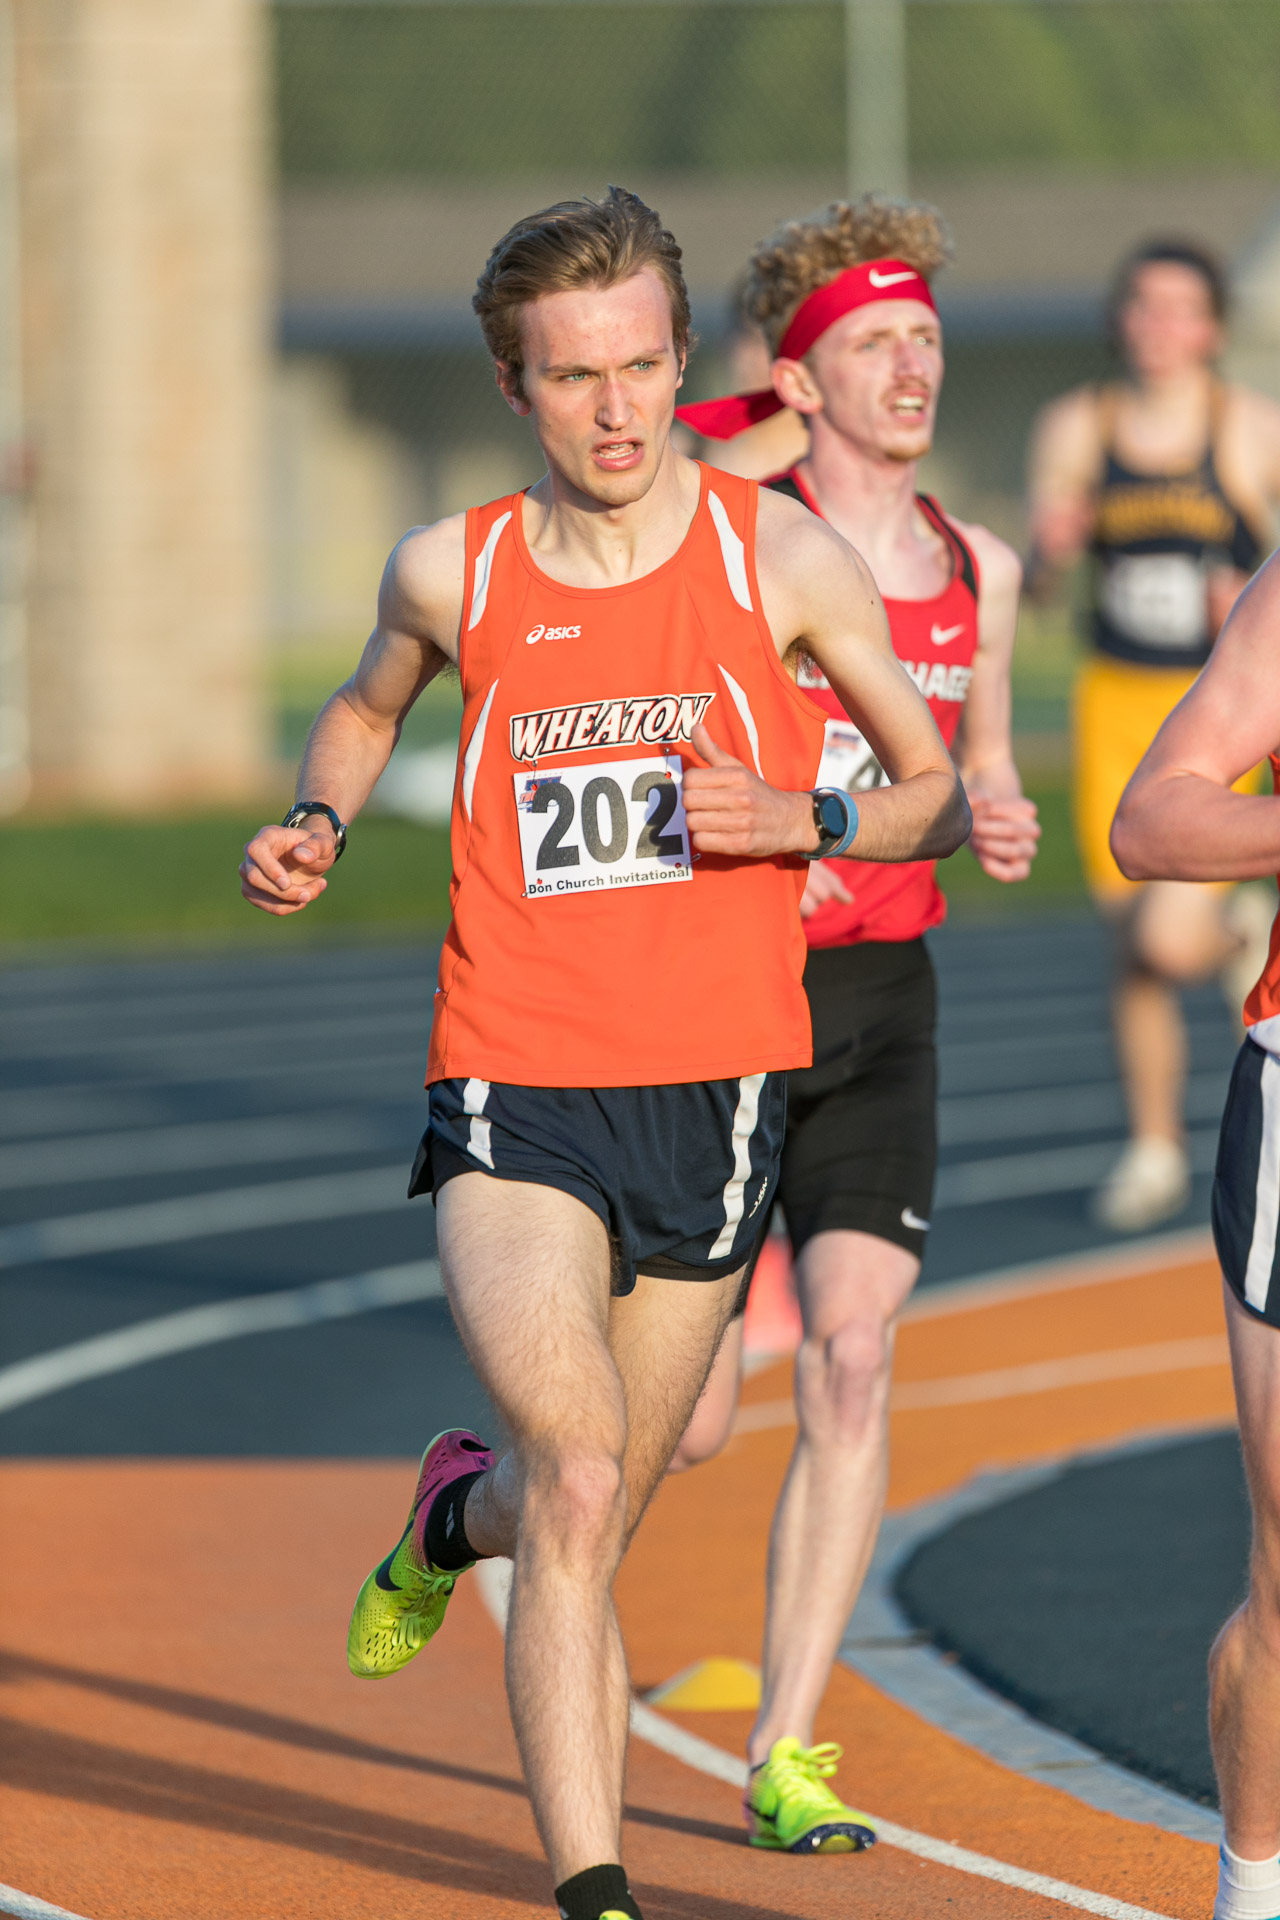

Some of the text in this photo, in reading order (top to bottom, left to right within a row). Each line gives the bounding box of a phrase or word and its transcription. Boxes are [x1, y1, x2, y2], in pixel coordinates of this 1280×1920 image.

[544, 625, 581, 640] asics
[511, 694, 715, 761] WHEATON
[531, 771, 684, 871] 202
[528, 866, 690, 895] Don Church Invitational
